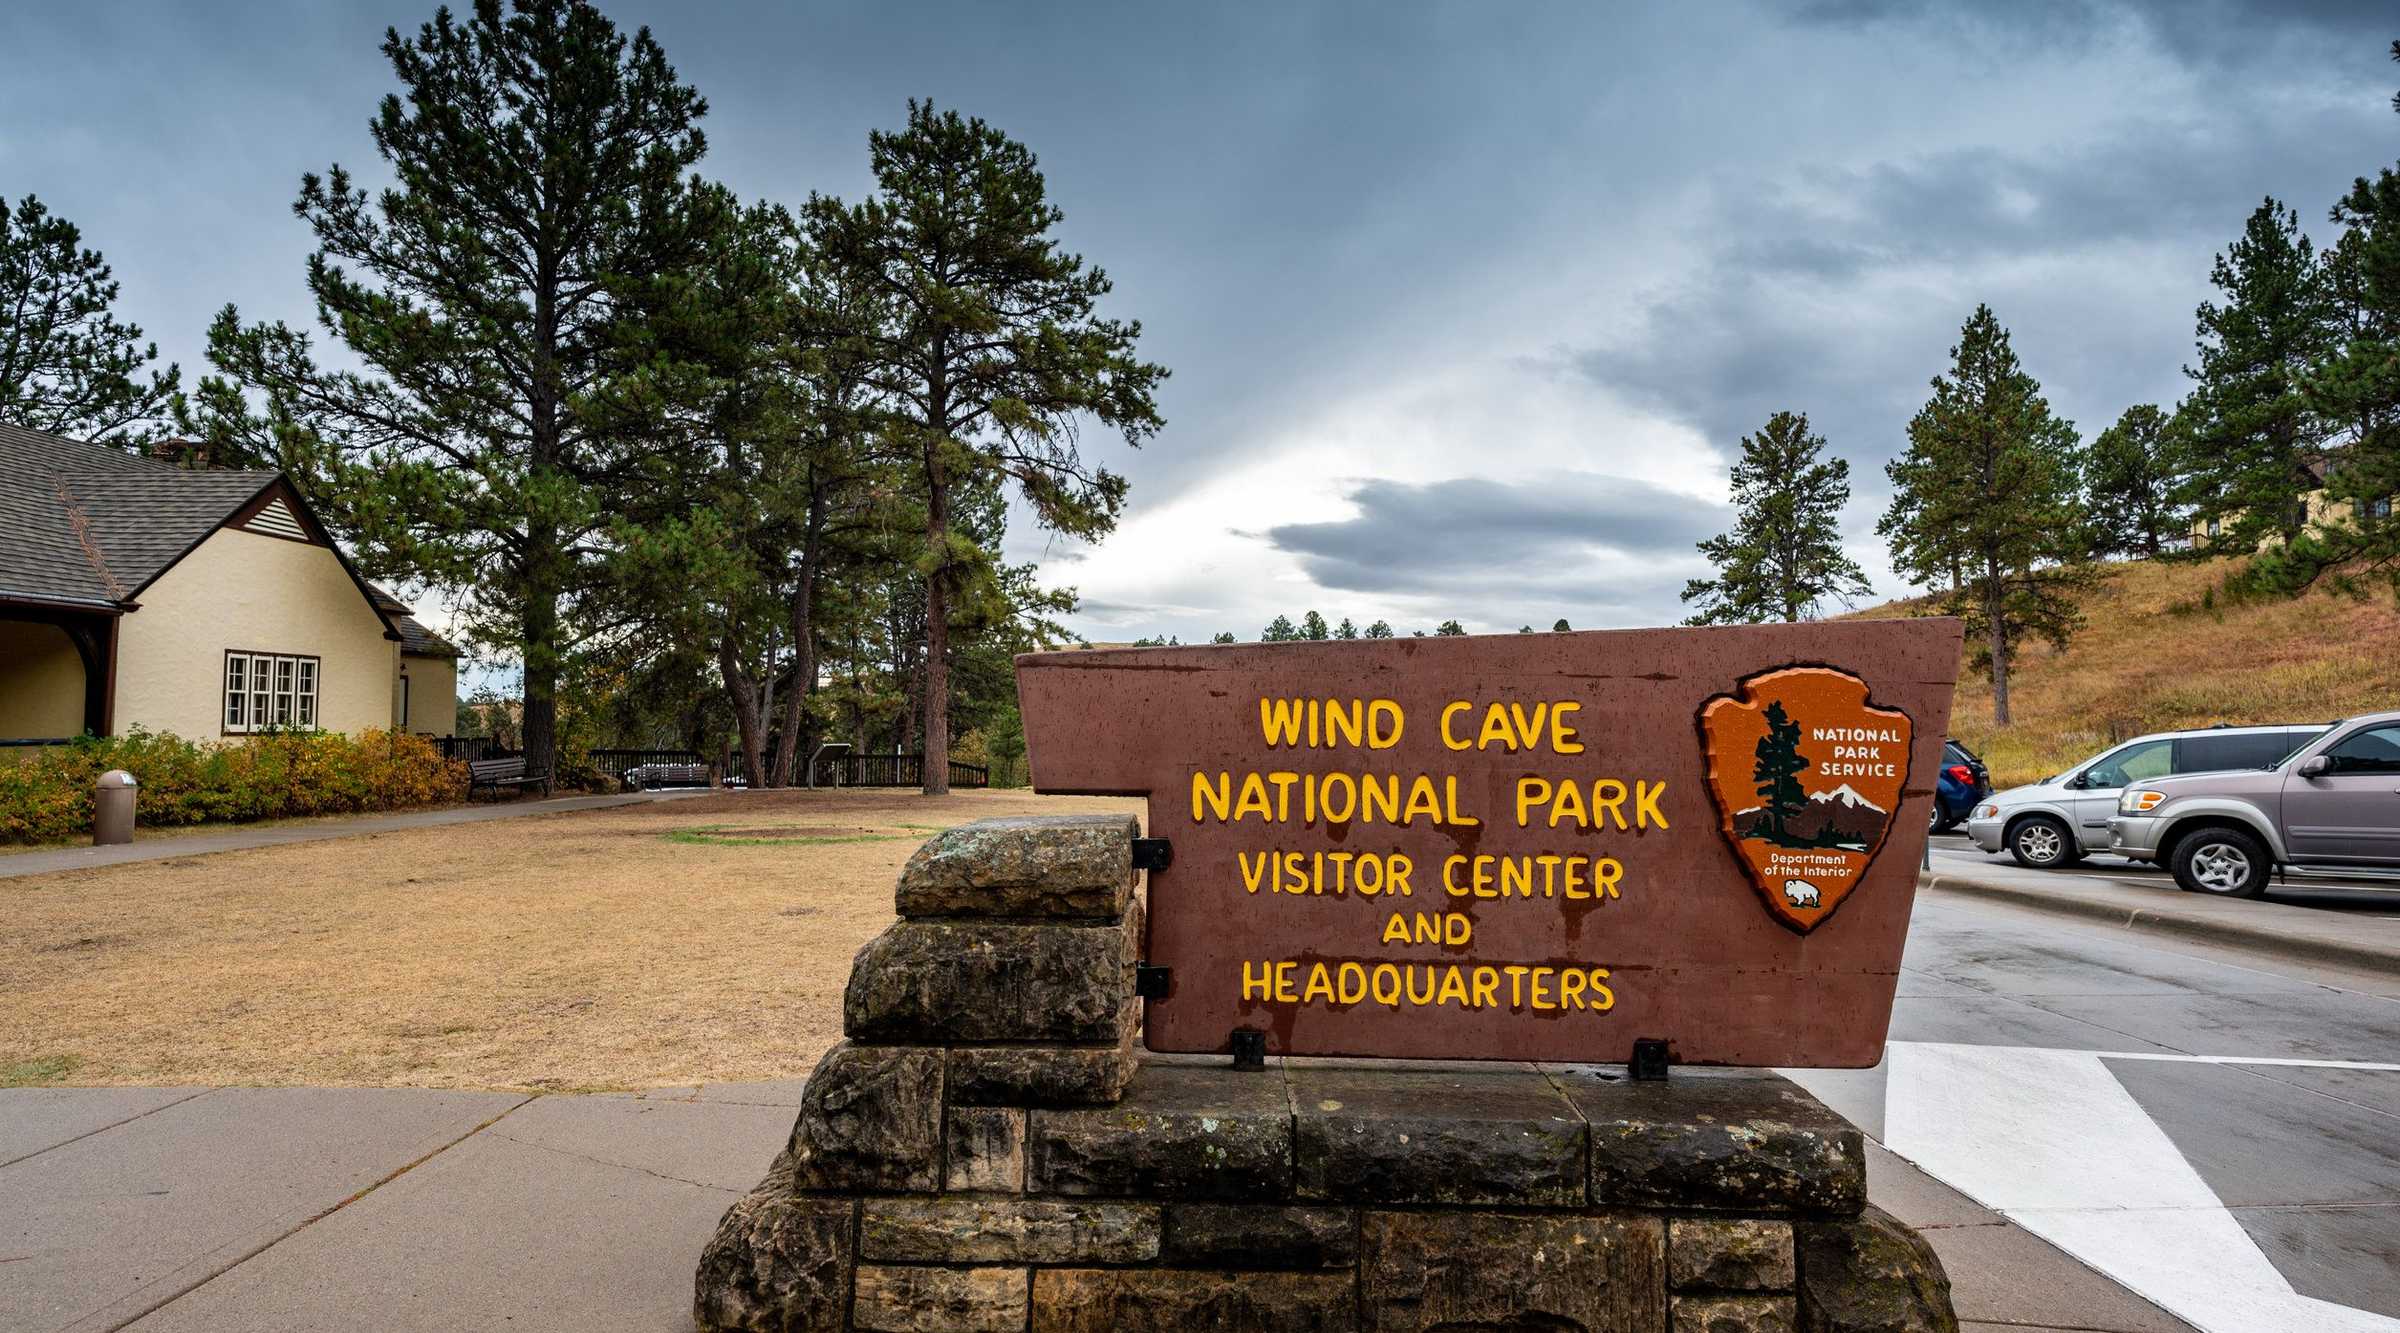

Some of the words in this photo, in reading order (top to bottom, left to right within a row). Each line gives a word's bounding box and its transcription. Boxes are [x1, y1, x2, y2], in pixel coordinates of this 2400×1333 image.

[1260, 698, 1404, 749] WIND
[1440, 701, 1583, 753] CAVE
[1813, 728, 1901, 742] NATIONAL
[1834, 746, 1880, 760] PARK
[1820, 762, 1895, 777] SERVICE
[1191, 771, 1479, 826] NATIONAL
[1516, 777, 1669, 830] PARK
[1764, 865, 1778, 876] of
[1781, 866, 1801, 876] the
[1804, 866, 1853, 877] Interior
[1771, 853, 1846, 865] Department
[1237, 851, 1413, 896] VISITOR
[1442, 855, 1624, 899] CENTER
[1382, 911, 1471, 945] AND
[1242, 960, 1614, 1010] HEADQUARTERS
